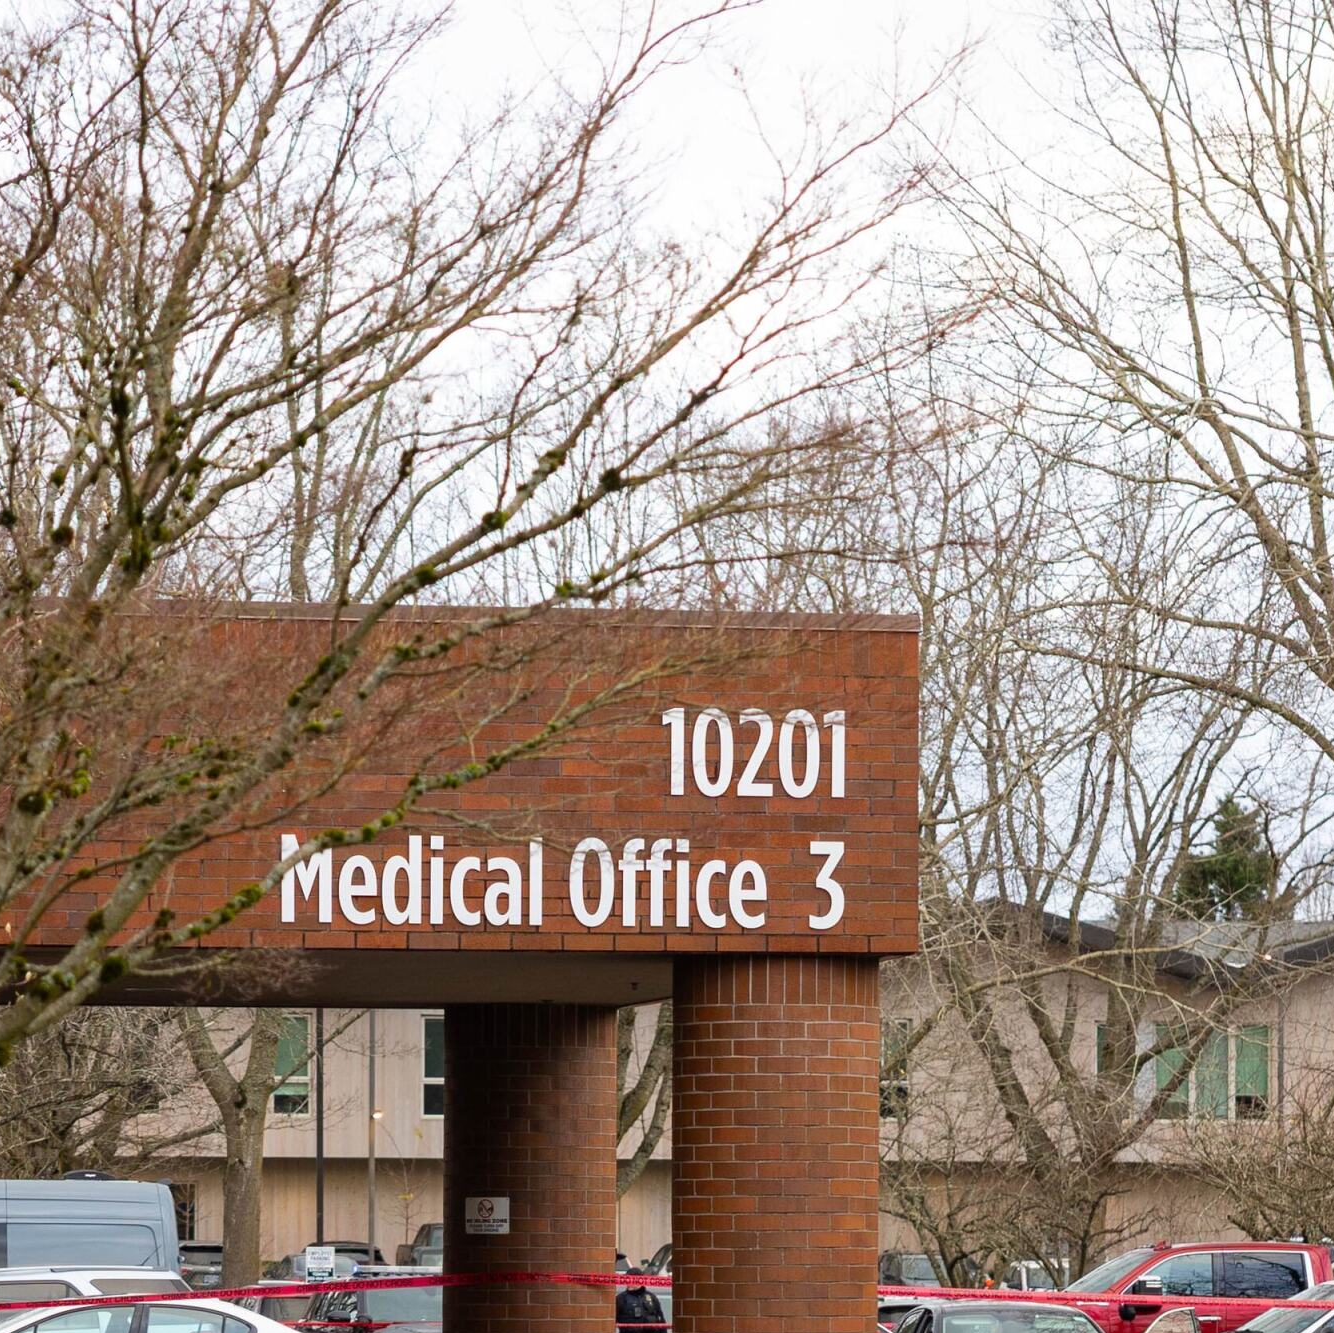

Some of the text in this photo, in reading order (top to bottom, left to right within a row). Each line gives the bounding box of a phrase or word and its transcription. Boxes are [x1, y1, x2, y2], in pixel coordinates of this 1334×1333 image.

[662, 708, 846, 798] 10201
[280, 833, 846, 931] Medical Office 3
[252, 1286, 281, 1296] CROSS
[323, 1282, 352, 1292] SCENE
[385, 1279, 412, 1288] CROSS
